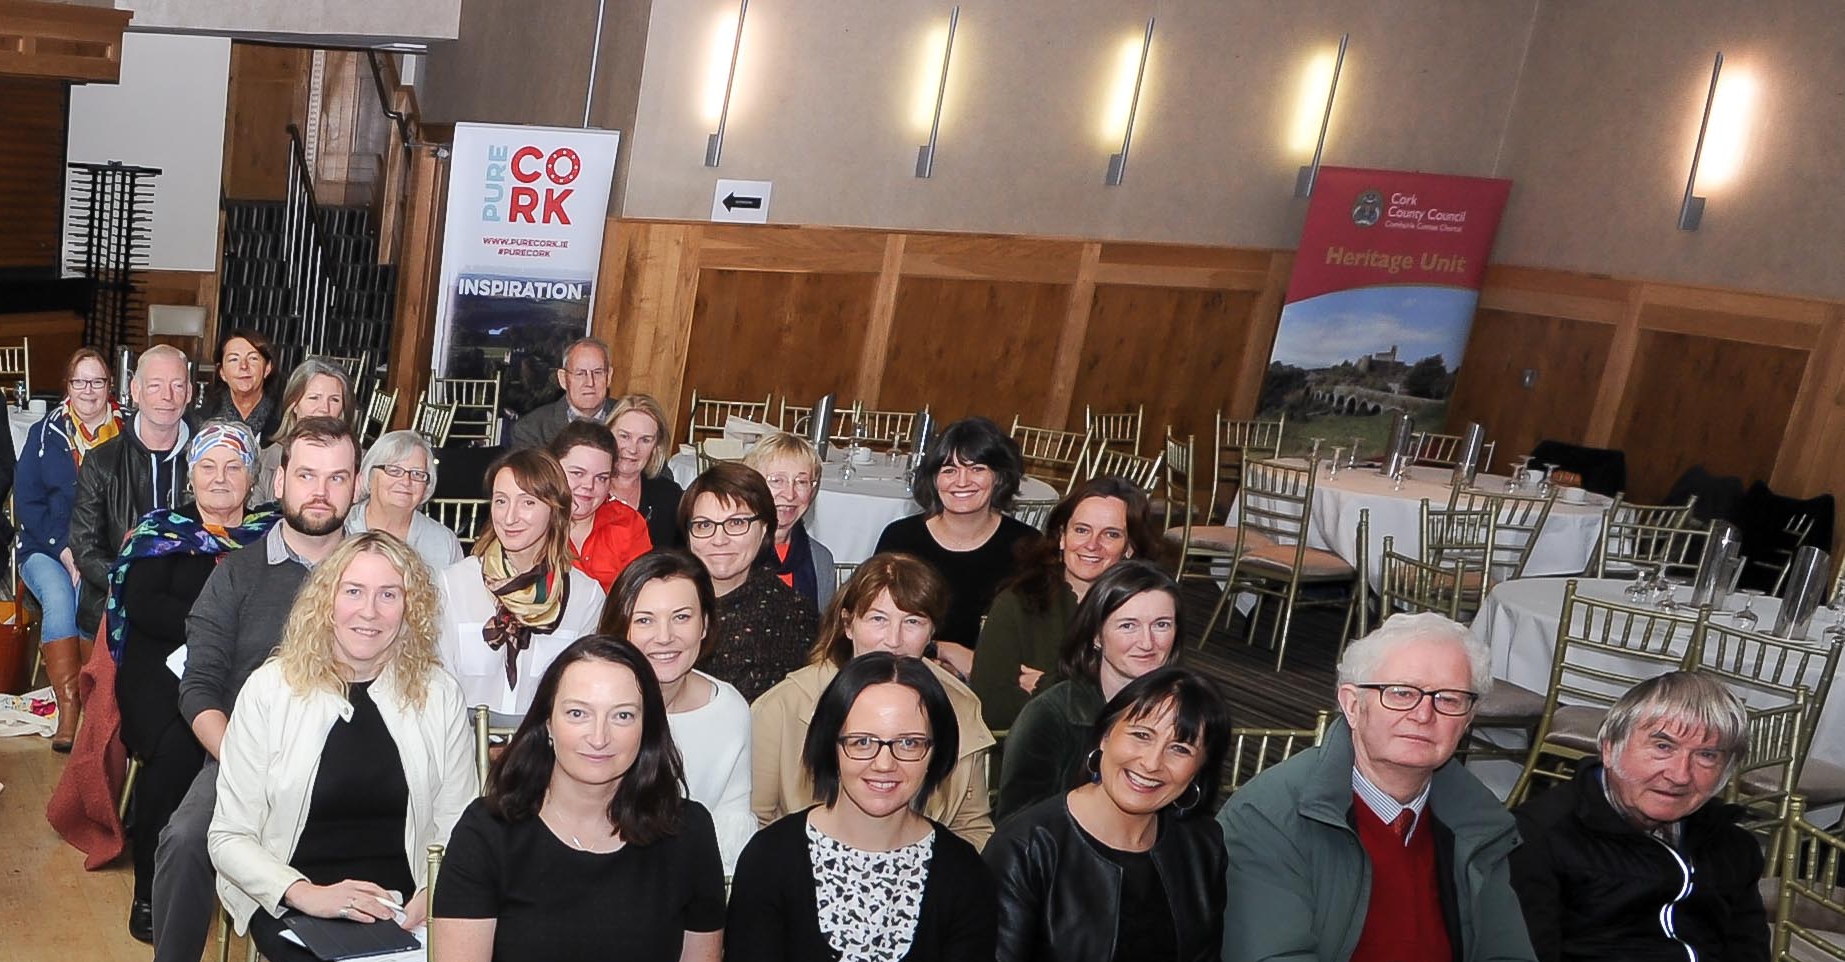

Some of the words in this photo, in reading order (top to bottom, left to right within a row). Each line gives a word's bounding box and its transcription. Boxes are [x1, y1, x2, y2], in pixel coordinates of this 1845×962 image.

[510, 145, 581, 186] CO
[482, 145, 508, 222] PURE
[508, 186, 574, 225] RK
[1391, 192, 1418, 205] Cork
[1388, 205, 1426, 222] County
[1427, 208, 1467, 222] Council
[482, 237, 569, 249] WWW.PURECORK.IE
[497, 248, 551, 258] #PURECORK
[1326, 246, 1414, 274] Heritage
[1419, 252, 1467, 273] Unit
[458, 278, 583, 300] INSPIRATION
